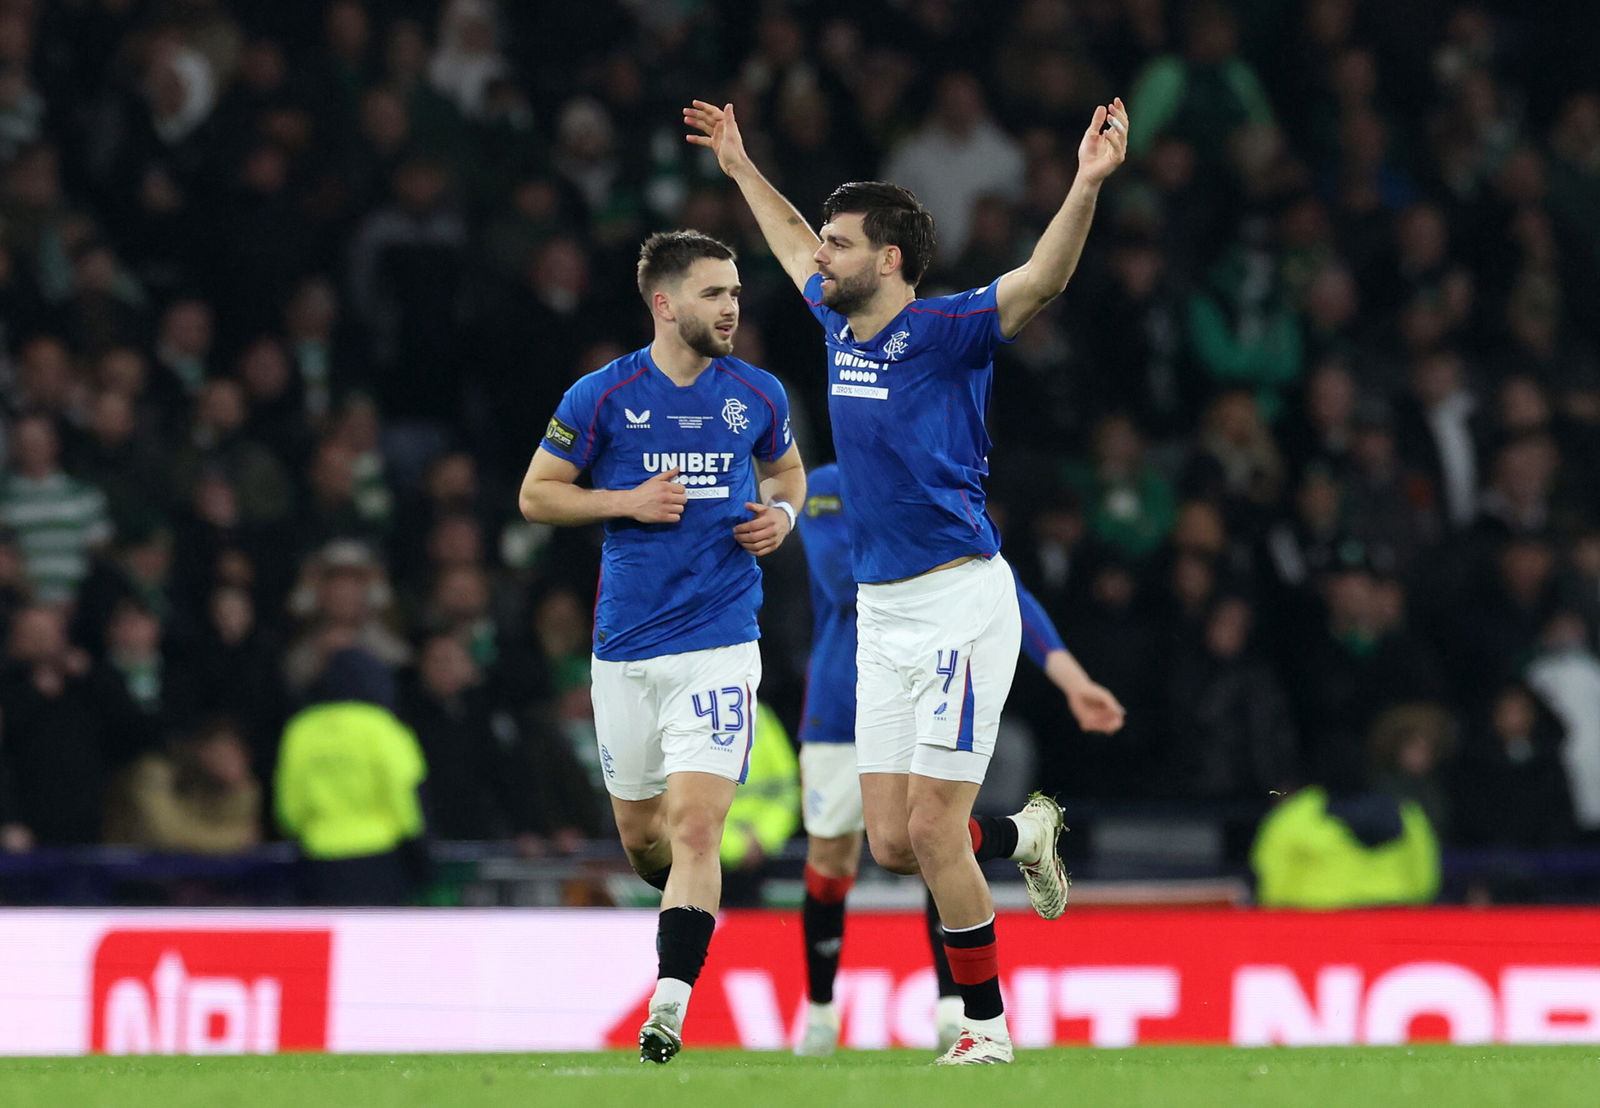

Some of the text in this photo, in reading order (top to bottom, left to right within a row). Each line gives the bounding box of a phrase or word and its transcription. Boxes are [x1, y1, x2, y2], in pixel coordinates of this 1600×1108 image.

[643, 452, 734, 473] UNIBET
[936, 650, 959, 694] 4
[692, 686, 744, 731] 43
